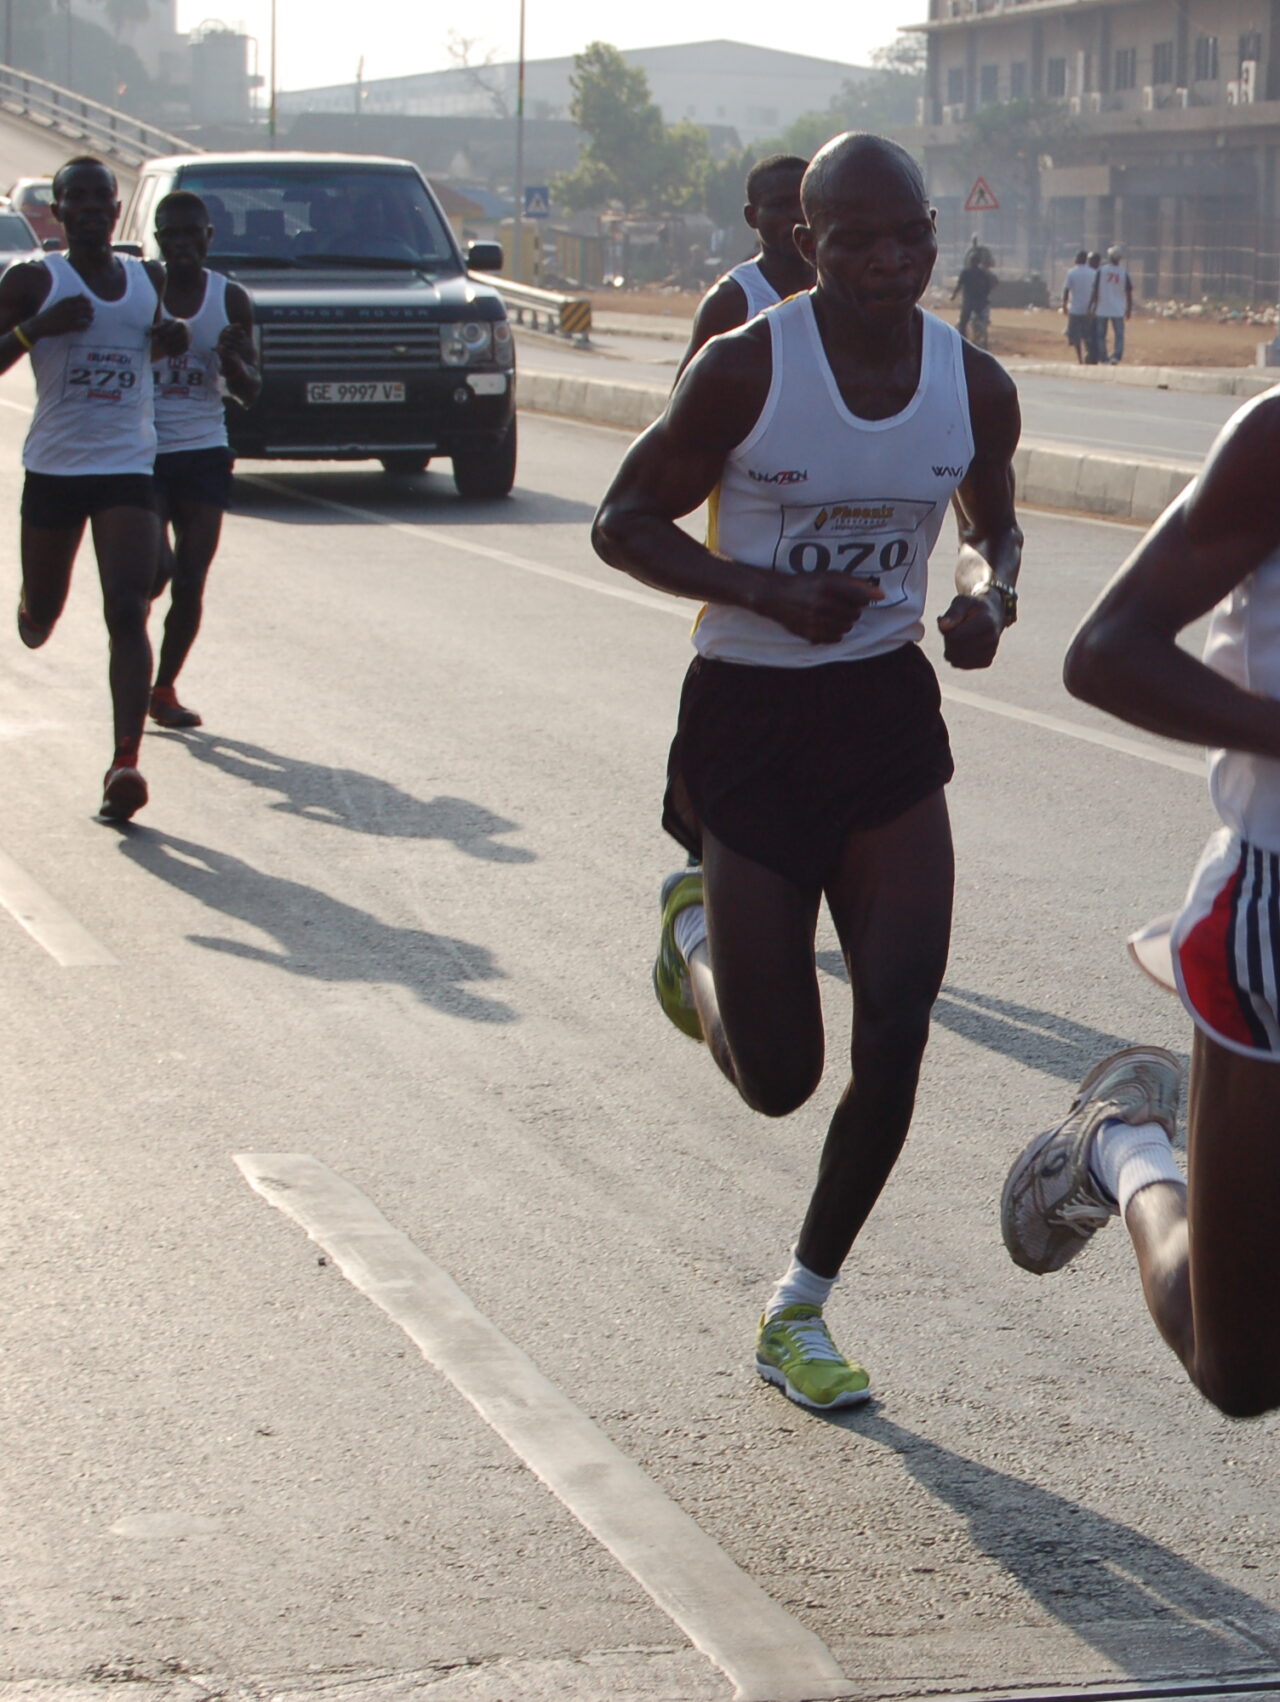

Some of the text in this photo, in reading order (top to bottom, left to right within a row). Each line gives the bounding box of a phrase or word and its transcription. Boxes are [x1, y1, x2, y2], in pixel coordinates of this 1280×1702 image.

[273, 308, 430, 317] RANGE ROVER
[69, 367, 136, 389] 279
[310, 384, 393, 401] GE 9997 V
[830, 504, 895, 519] Phoenix
[788, 538, 909, 575] 070
